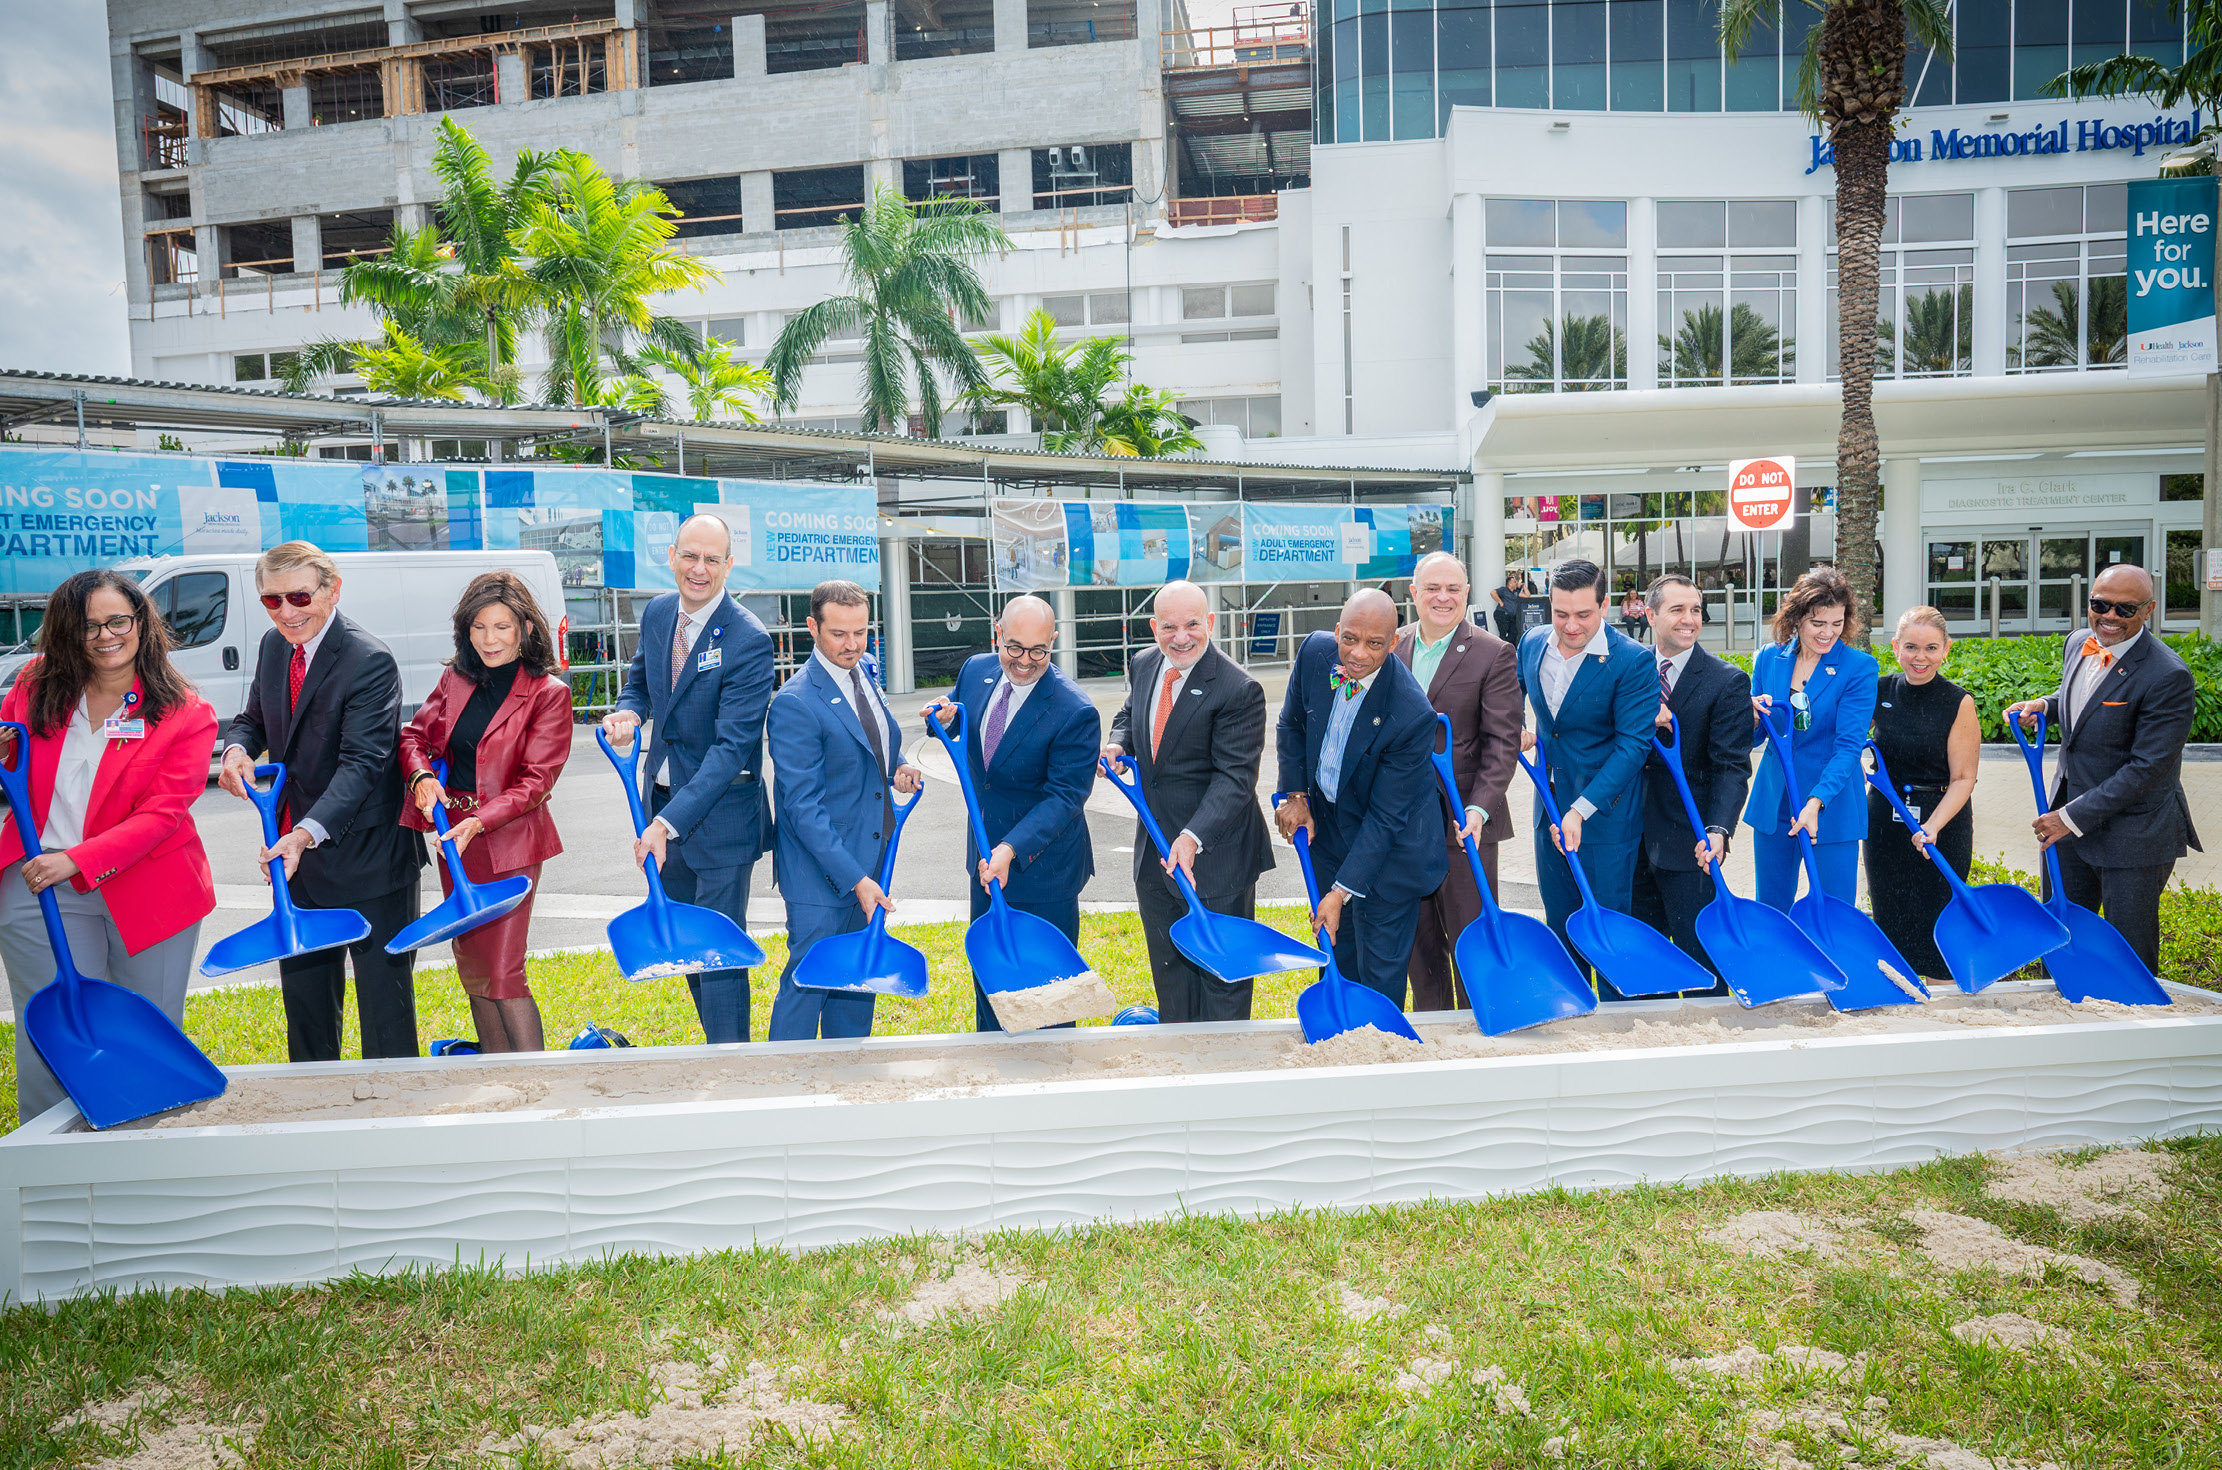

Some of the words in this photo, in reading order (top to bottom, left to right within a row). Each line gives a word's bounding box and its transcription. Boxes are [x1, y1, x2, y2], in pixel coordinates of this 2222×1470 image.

[1805, 135, 1923, 175] Jaon
[1931, 119, 2070, 161] Memorial
[2077, 110, 2201, 157] Hospital
[2136, 212, 2210, 237] Here
[2154, 239, 2192, 262] for
[2134, 267, 2208, 298] you.
[2178, 340, 2204, 350] Jackson
[2133, 353, 2189, 364] Rehabilitation
[2190, 352, 2212, 361] Care
[1739, 473, 1755, 486] DO
[1761, 472, 1785, 485] NOT
[1997, 483, 2016, 495] Ira
[2019, 482, 2035, 494] C.
[2039, 480, 2077, 493] Clark
[64, 487, 158, 510] SOON
[1949, 497, 2016, 509] DIAGNOSTIC
[2017, 495, 2081, 507] TREATMENT
[2082, 493, 2127, 505] CENTER
[1742, 503, 1779, 516] ENTER
[20, 514, 158, 532] EMERGENCY
[202, 511, 241, 525] Jackson
[765, 511, 840, 530] COMING
[843, 515, 877, 531] SOO
[1252, 524, 1300, 537] COMING
[1302, 525, 1335, 537] SOON
[765, 530, 776, 562] NEW
[777, 532, 831, 544] PEDIATRIC
[832, 535, 879, 546] EMERGEN
[1260, 539, 1287, 549] ADULT
[1287, 540, 1336, 549] EMERGENCY
[777, 545, 879, 563] DEPARTMEN
[1251, 538, 1259, 561] NEW
[1259, 549, 1336, 562] DEPARTMENT
